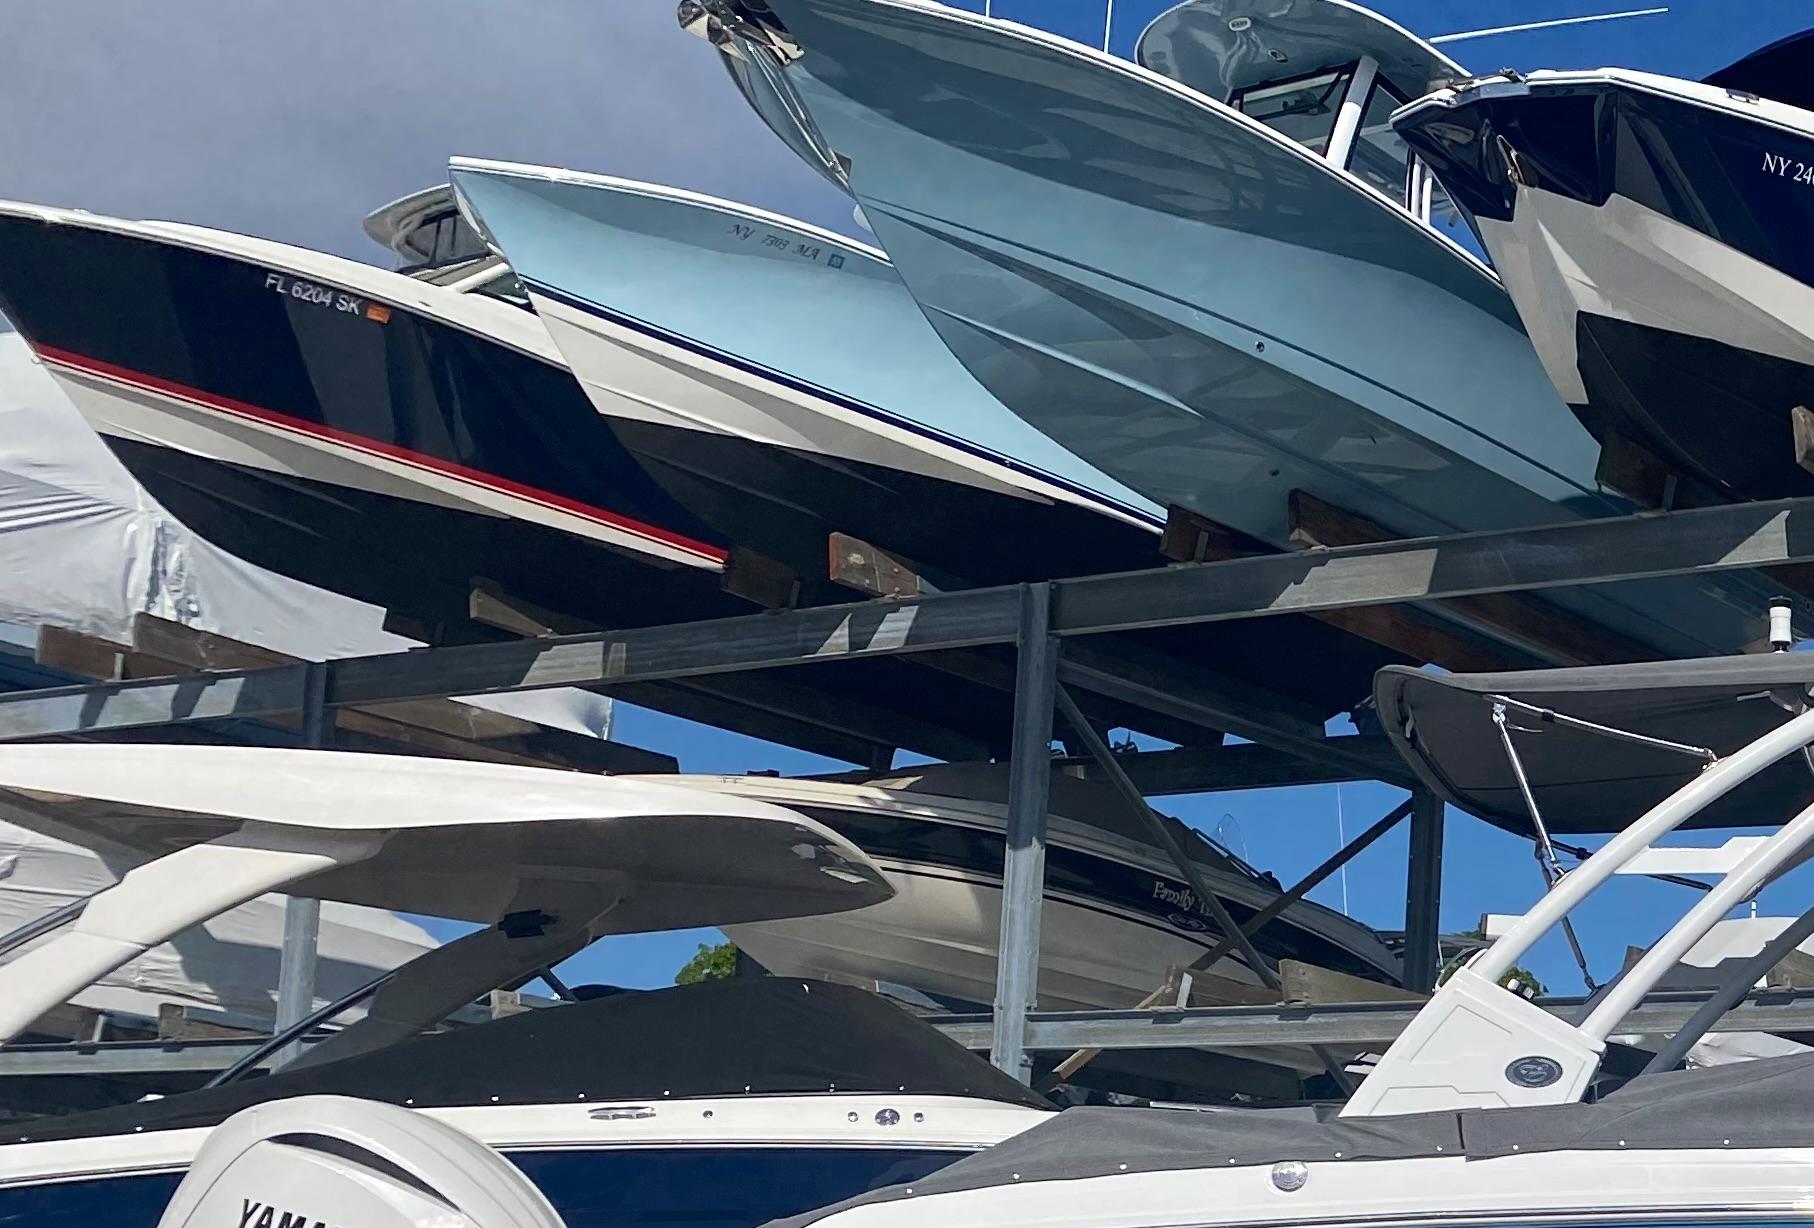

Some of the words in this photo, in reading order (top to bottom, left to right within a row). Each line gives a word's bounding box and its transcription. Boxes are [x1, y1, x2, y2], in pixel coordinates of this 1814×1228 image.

[1761, 151, 1792, 177] NY
[728, 223, 755, 241] NY
[264, 272, 287, 294] FL
[291, 281, 332, 308] 6204
[335, 294, 362, 316] SK
[1152, 880, 1195, 911] Family
